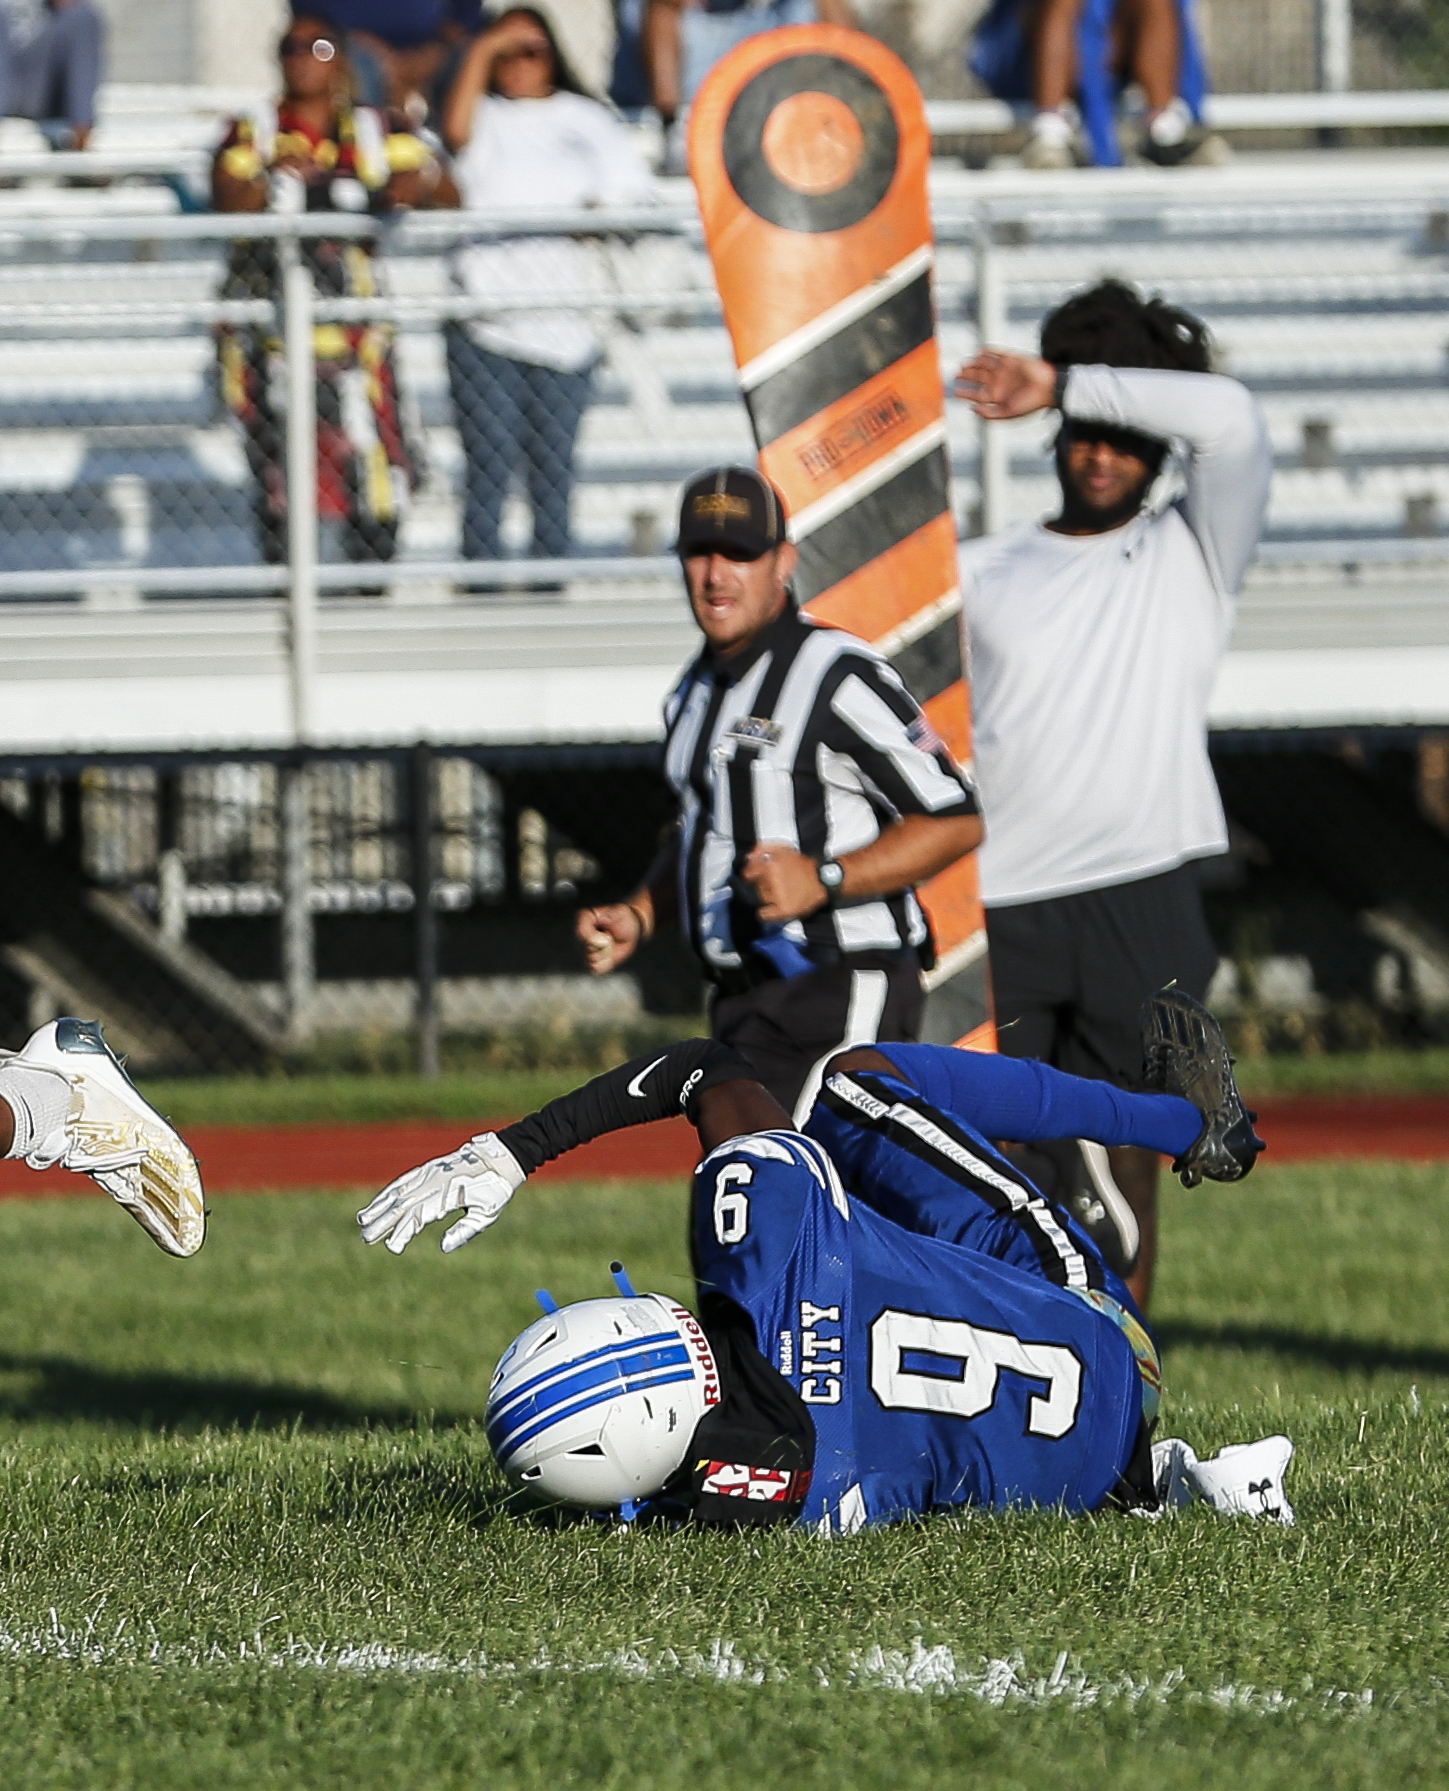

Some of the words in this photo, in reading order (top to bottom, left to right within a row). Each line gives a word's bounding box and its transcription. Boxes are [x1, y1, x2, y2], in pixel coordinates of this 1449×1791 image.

[671, 1307, 722, 1407] Riddell
[779, 1330, 794, 1377] Riddell
[800, 1300, 842, 1405] CITY
